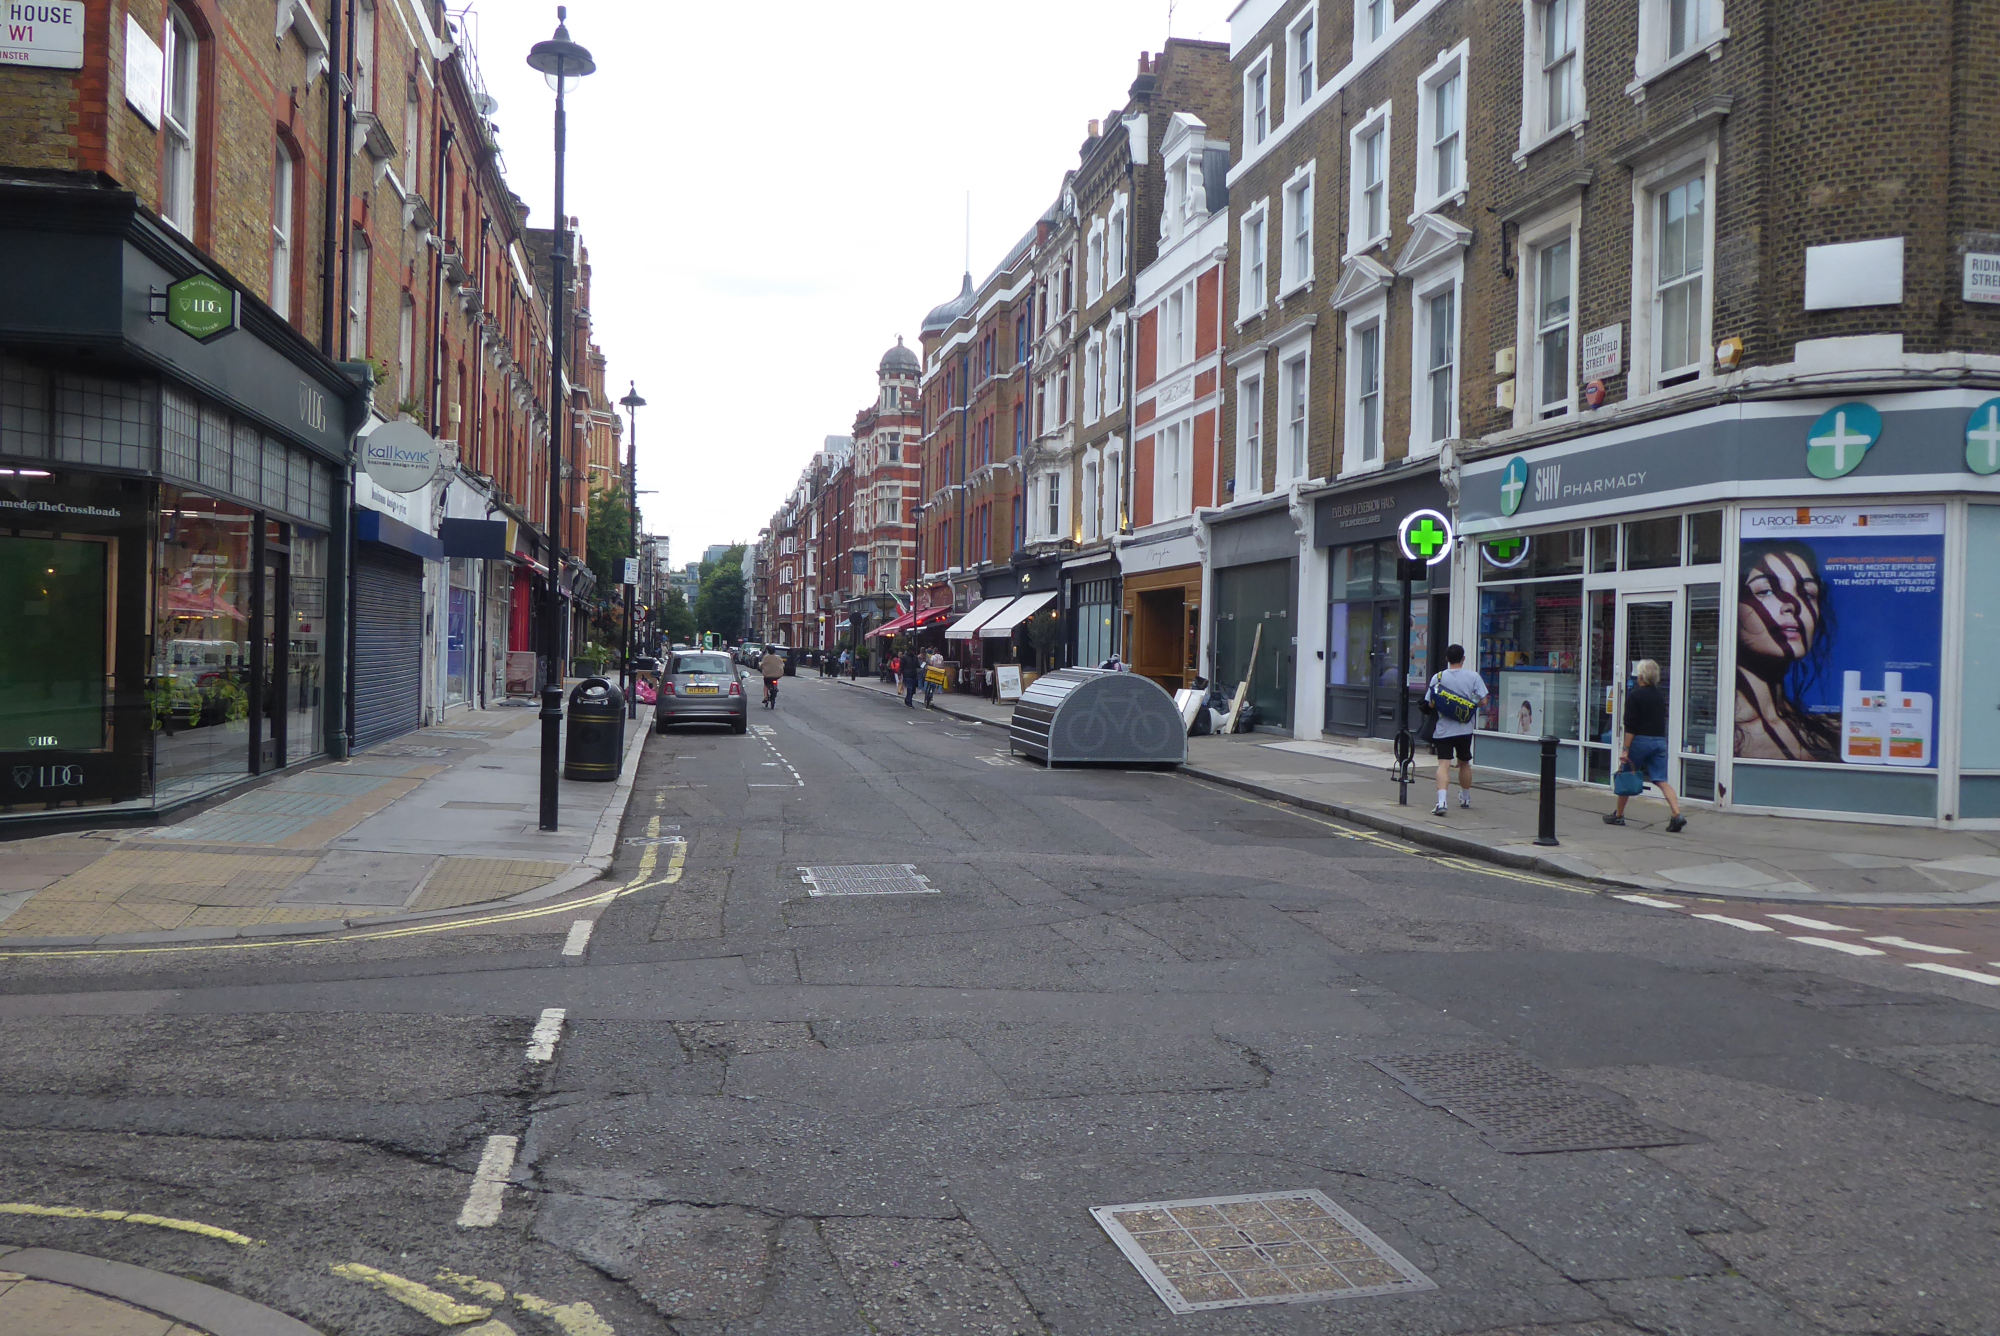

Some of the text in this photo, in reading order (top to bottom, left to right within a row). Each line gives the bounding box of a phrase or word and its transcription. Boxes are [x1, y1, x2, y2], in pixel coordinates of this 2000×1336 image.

[11, 4, 72, 24] HOUSE
[9, 24, 33, 42] W1
[194, 298, 222, 314] LDG
[1585, 332, 1604, 347] GREAT
[1586, 340, 1618, 358] TITCHFIELD
[1585, 353, 1616, 371] STREET W1
[308, 387, 327, 433] LDG
[1535, 464, 1647, 502] SHIV PHARMACY
[1752, 516, 1767, 527] LA
[39, 764, 84, 788] LDG
